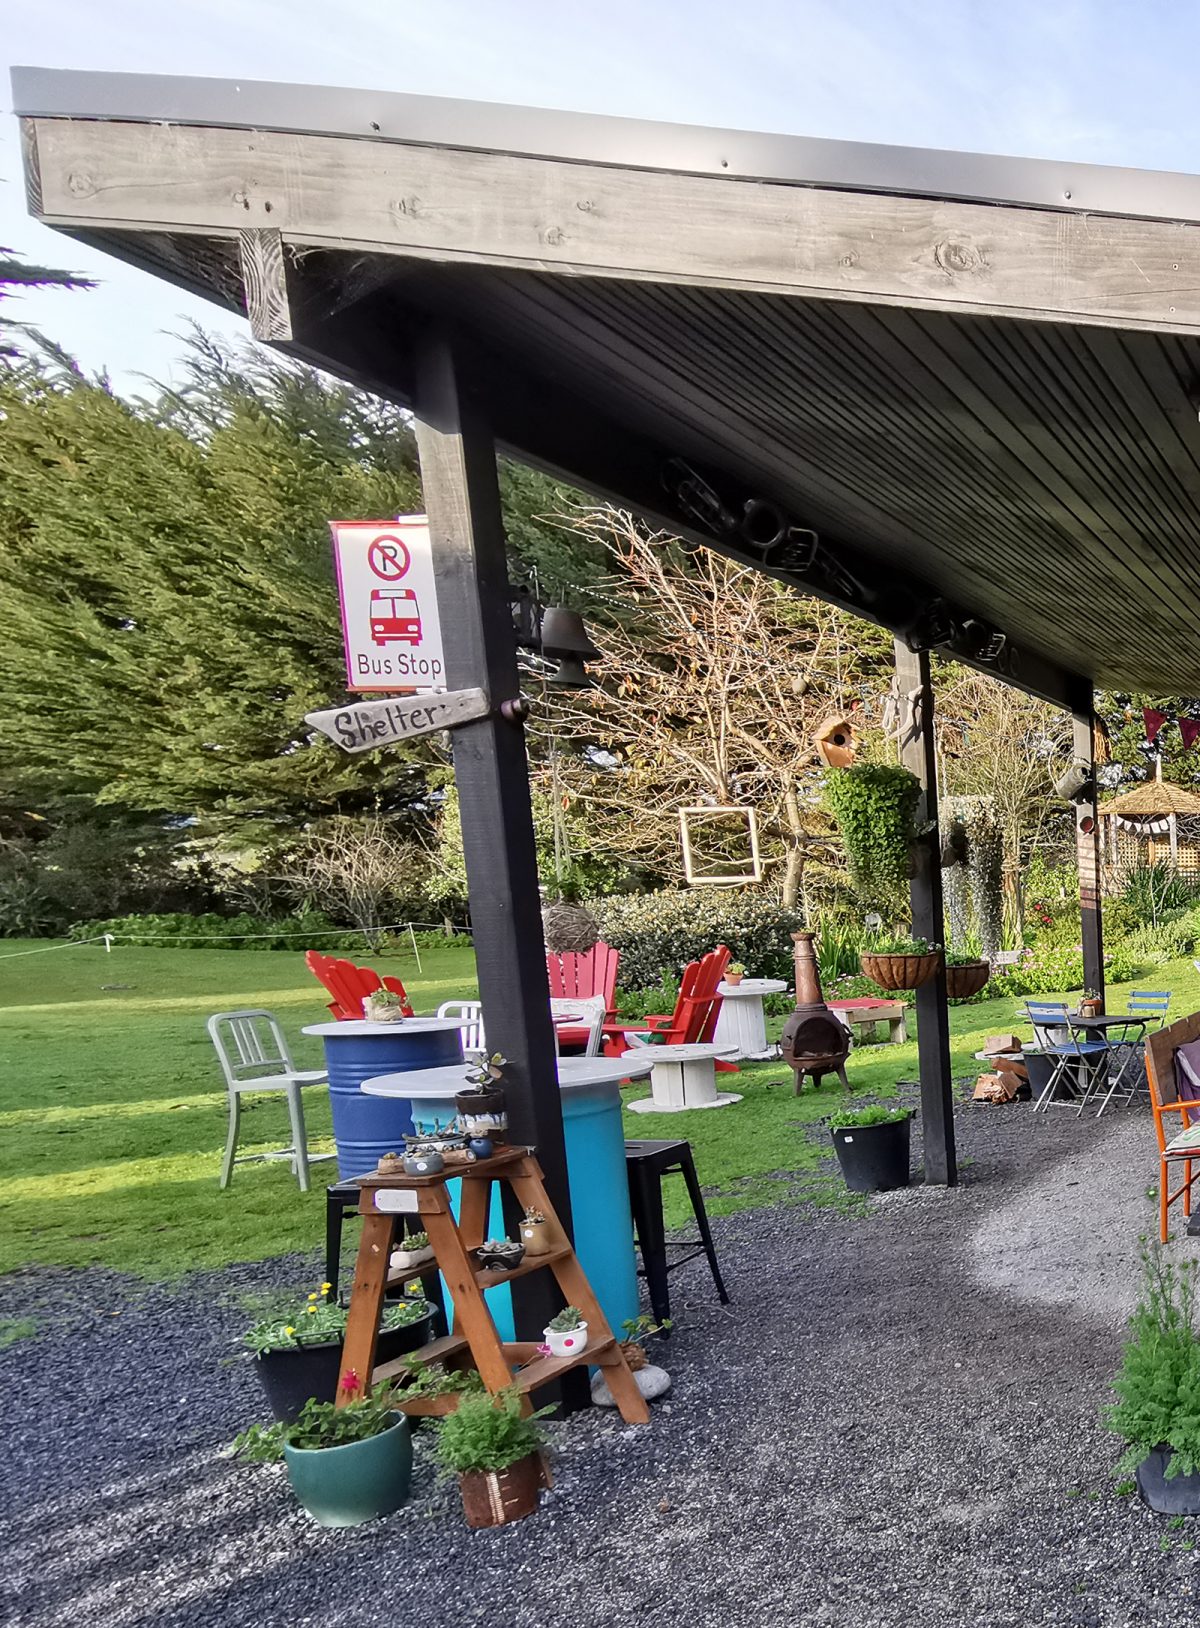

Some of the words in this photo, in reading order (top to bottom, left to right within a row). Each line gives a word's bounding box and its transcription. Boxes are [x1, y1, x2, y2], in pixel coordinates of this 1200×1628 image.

[357, 653, 393, 675] Bus
[397, 653, 442, 680] Stop
[334, 704, 437, 749] Shelter
